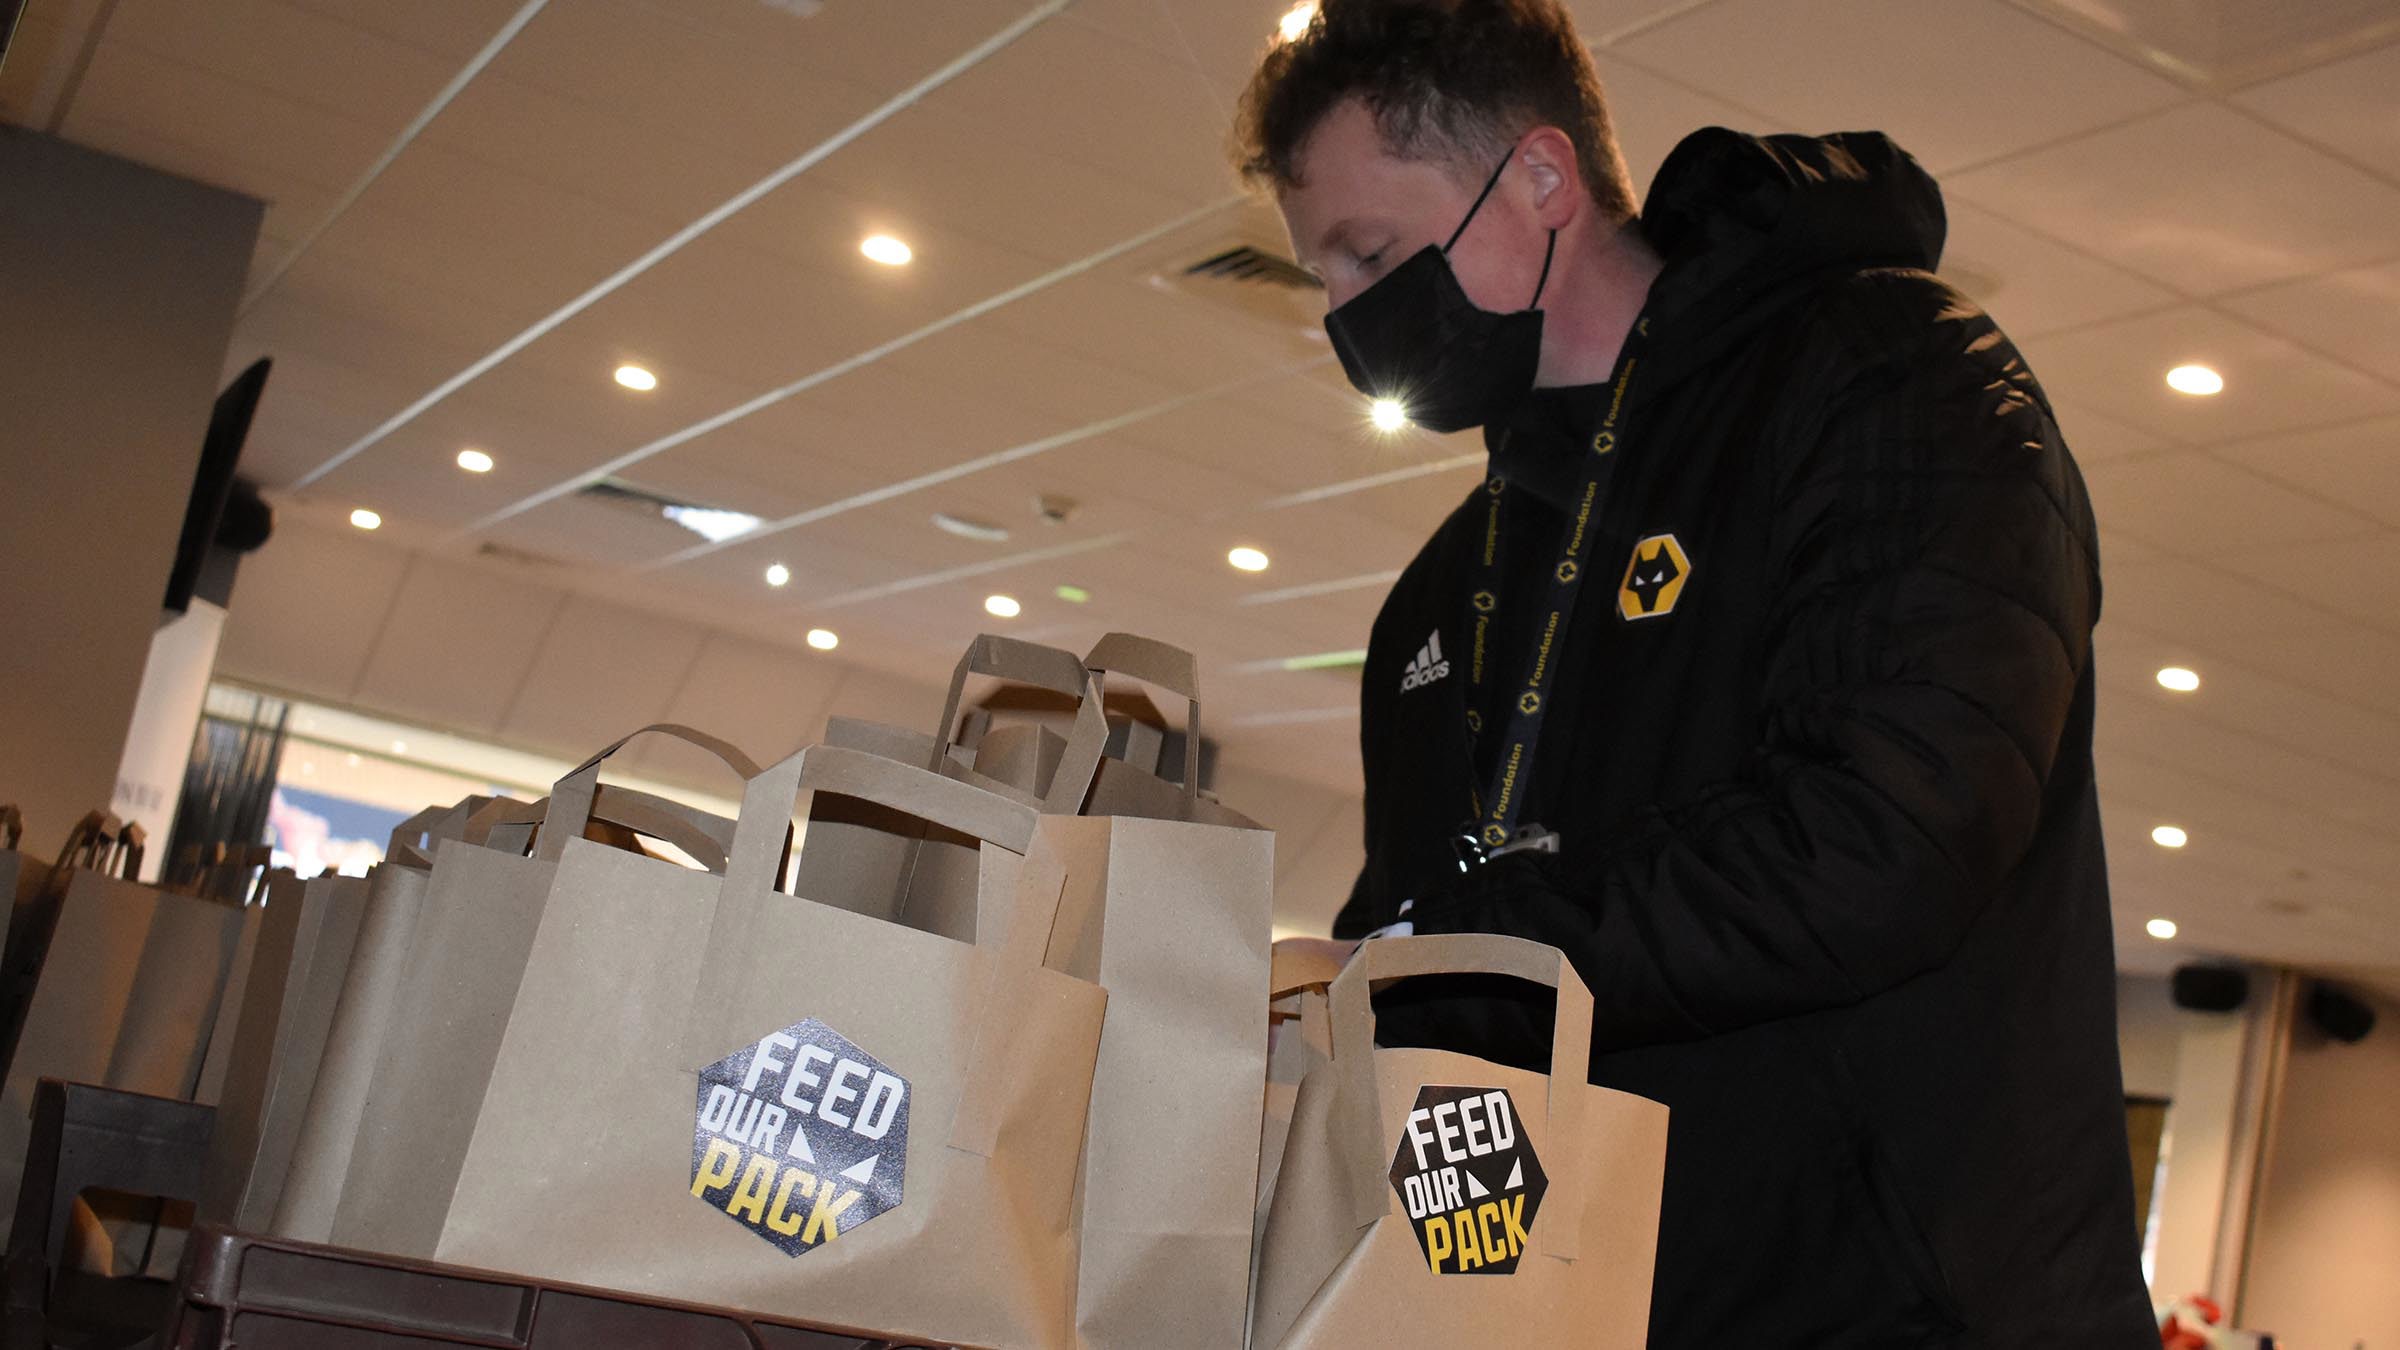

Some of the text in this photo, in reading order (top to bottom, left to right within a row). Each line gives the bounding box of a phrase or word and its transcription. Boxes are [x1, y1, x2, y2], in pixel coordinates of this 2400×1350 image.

[1566, 481, 1597, 556] Foundation
[1529, 610, 1560, 687] Foundation
[1492, 743, 1523, 820] Foundation
[700, 1084, 788, 1154] OUR
[742, 1031, 905, 1140] FEED
[1406, 1091, 1515, 1170] FEED
[690, 1137, 864, 1244] PACK
[1404, 1166, 1464, 1219] OUR
[1425, 1193, 1528, 1275] PACK
